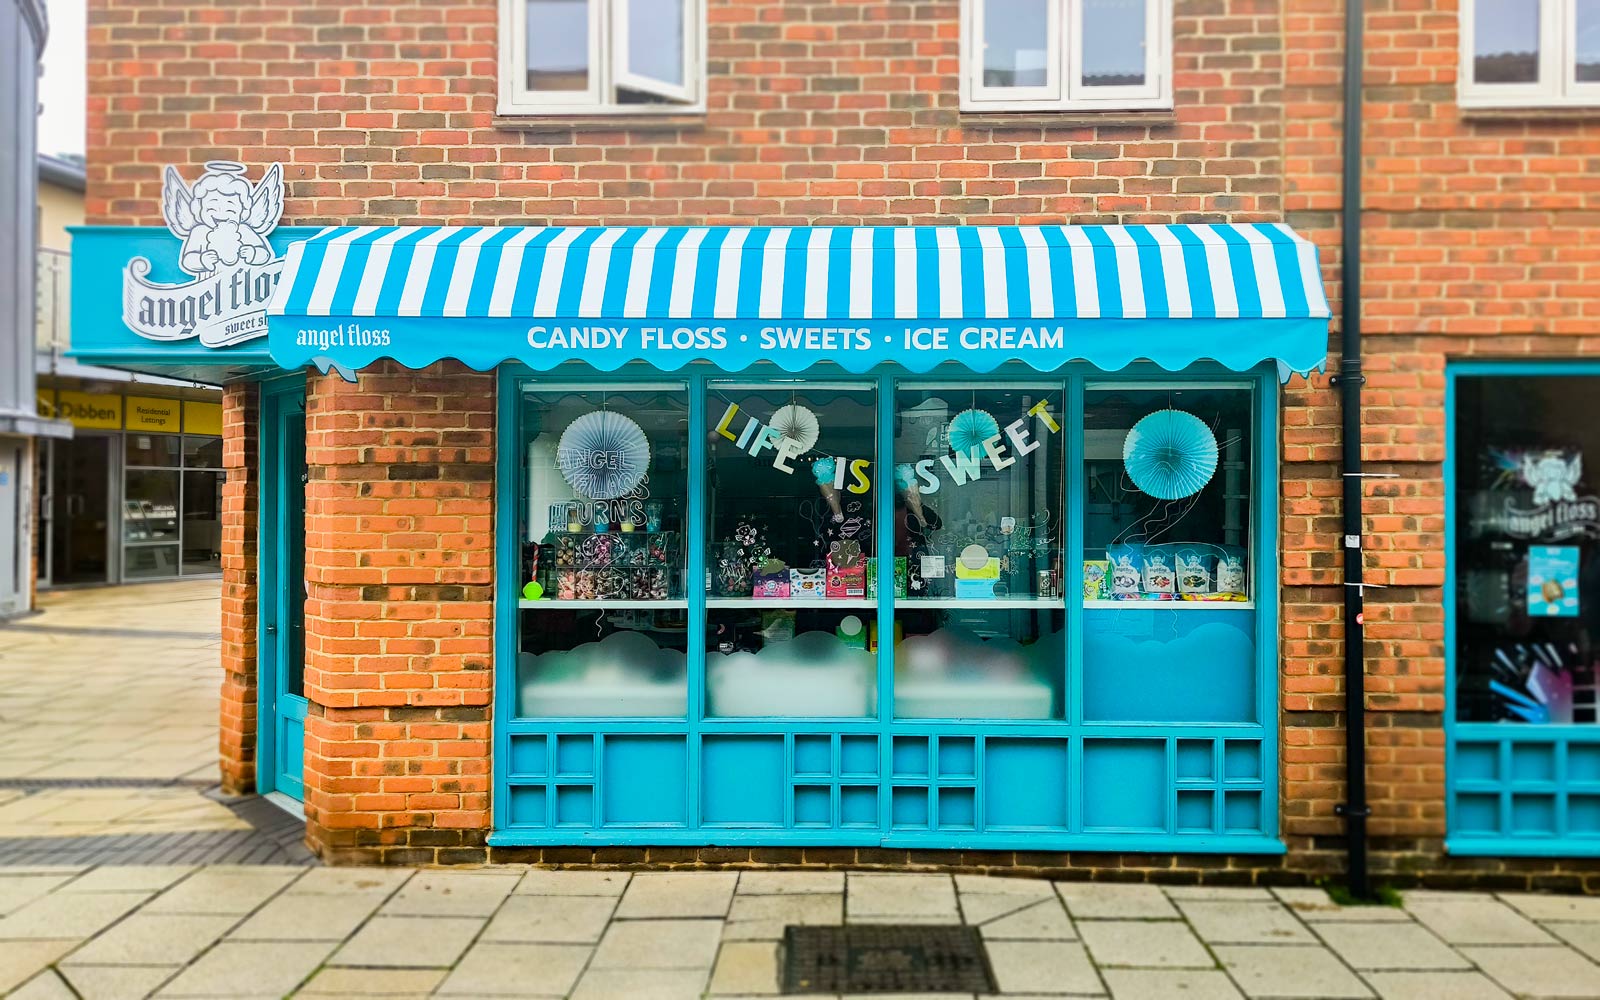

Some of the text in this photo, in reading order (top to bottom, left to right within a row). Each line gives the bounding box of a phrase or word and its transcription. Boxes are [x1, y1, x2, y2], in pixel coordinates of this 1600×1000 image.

[138, 267, 284, 335] angel flo
[225, 316, 256, 336] sweet
[296, 323, 391, 351] angel floss
[527, 326, 1064, 350] CANDY FLOSS SWEETS ICE CREAM
[61, 401, 115, 421] Dibben
[136, 406, 171, 416] Residential
[141, 416, 166, 426] Lettings
[715, 398, 1061, 495] LIFE IS SWEET
[553, 449, 637, 471] ANGEL
[573, 472, 650, 500] FLOSS
[566, 499, 648, 527] TURNS
